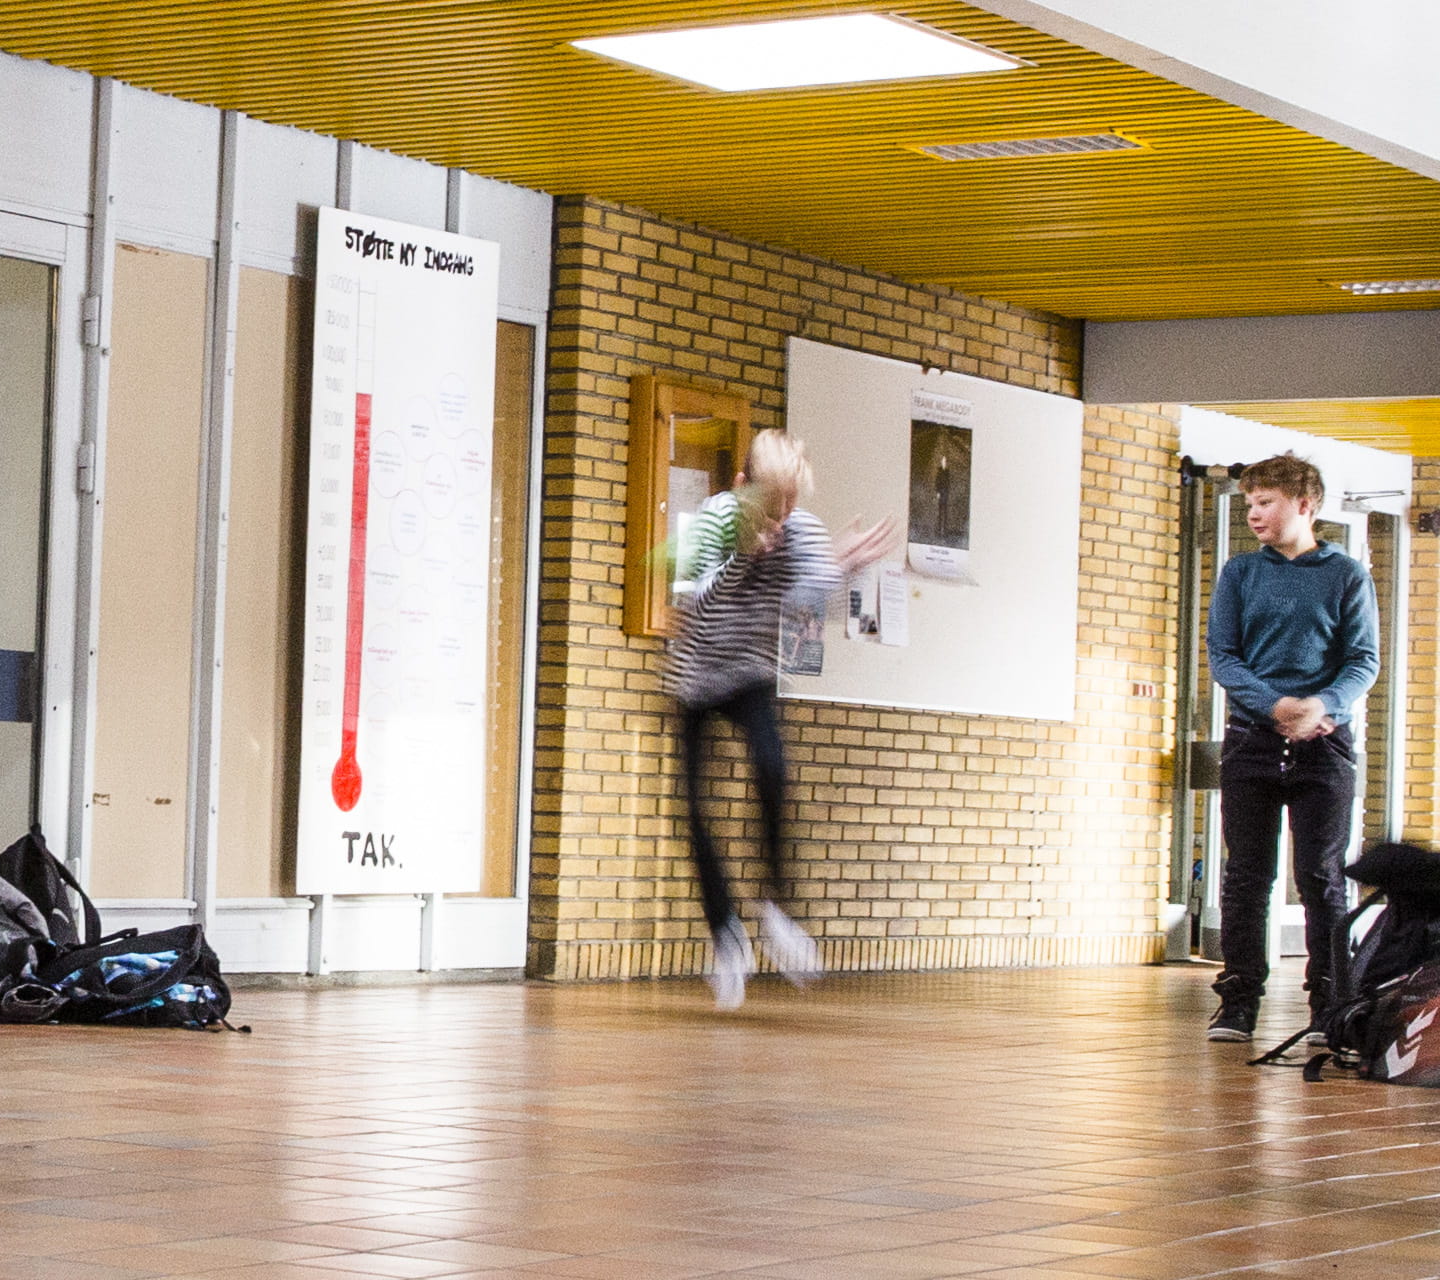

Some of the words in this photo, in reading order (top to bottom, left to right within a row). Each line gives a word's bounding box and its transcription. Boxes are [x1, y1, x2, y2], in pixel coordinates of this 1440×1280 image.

[345, 226, 394, 261] STØTTE
[399, 242, 418, 267] NY
[341, 830, 403, 869] TAK.
